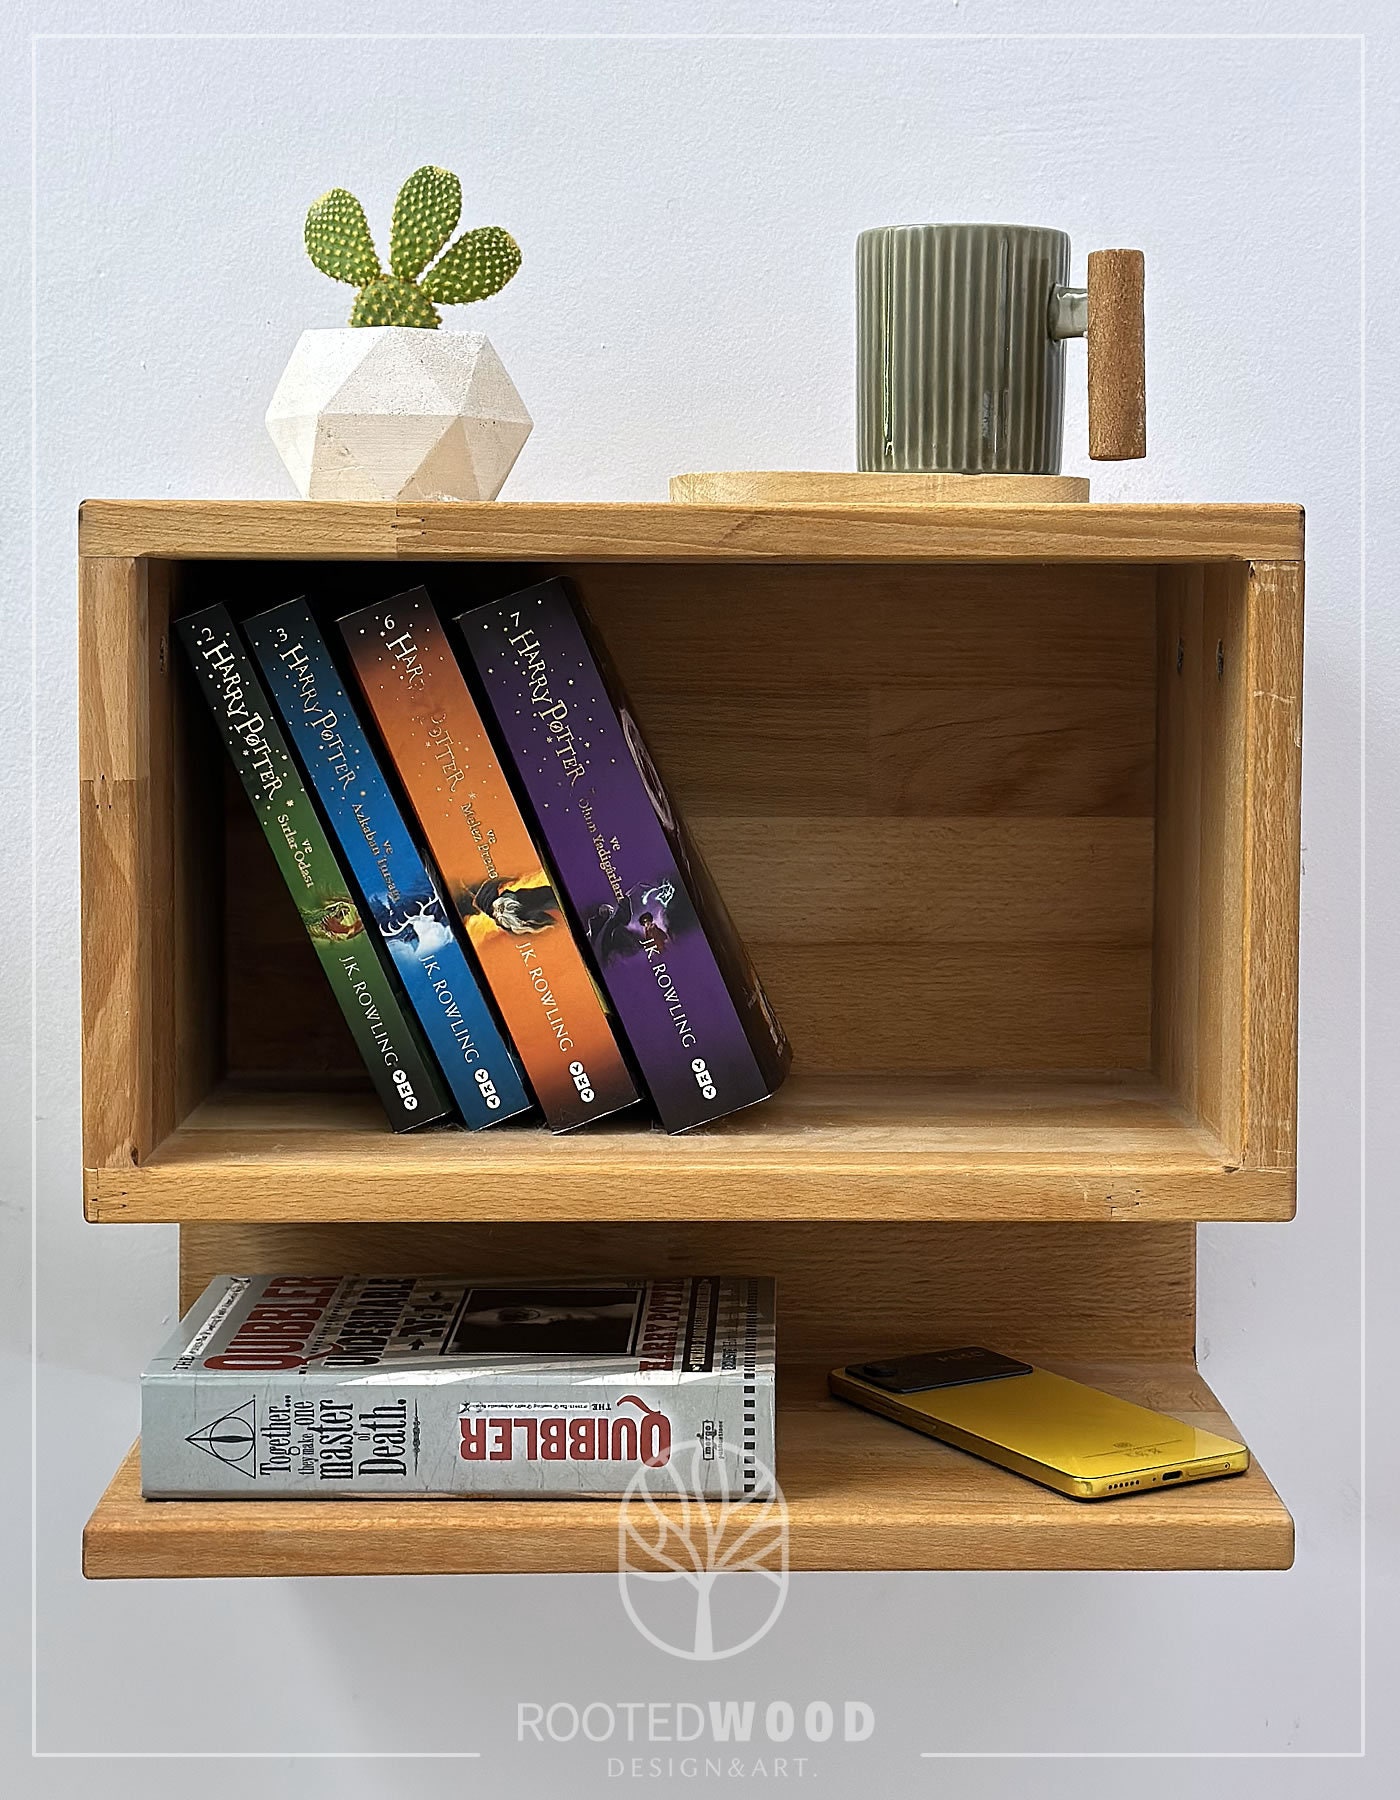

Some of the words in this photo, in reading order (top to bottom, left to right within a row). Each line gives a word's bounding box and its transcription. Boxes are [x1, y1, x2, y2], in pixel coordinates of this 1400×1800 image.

[202, 627, 214, 642] 2
[276, 627, 288, 642] 3
[384, 614, 395, 630] 6
[510, 612, 521, 627] 7
[203, 641, 248, 716] HARRY
[233, 711, 282, 801] POTTER
[280, 643, 322, 715] HARRY
[310, 709, 356, 790] POTTER
[509, 631, 552, 704] HARRY
[538, 699, 586, 788] POTTER
[301, 838, 313, 855] ve
[610, 836, 622, 851] ve
[339, 956, 361, 981] J.K.
[352, 980, 398, 1067] ROWLING
[420, 955, 441, 980] J.K.
[434, 979, 480, 1064] ROWLING
[515, 943, 537, 968] J.K.
[529, 967, 574, 1053] ROWLING
[639, 938, 661, 963] J.K.
[652, 963, 697, 1049] ROWLING
[203, 1275, 346, 1371] QUIBBLER
[260, 1394, 300, 1476] Together...
[293, 1401, 315, 1426] one
[307, 1399, 354, 1480] master
[353, 1431, 371, 1441] of
[358, 1398, 407, 1477] Death.
[459, 1394, 672, 1468] QUIBBLER
[591, 1402, 612, 1411] THE
[297, 1456, 318, 1475] they
[298, 1433, 314, 1455] make
